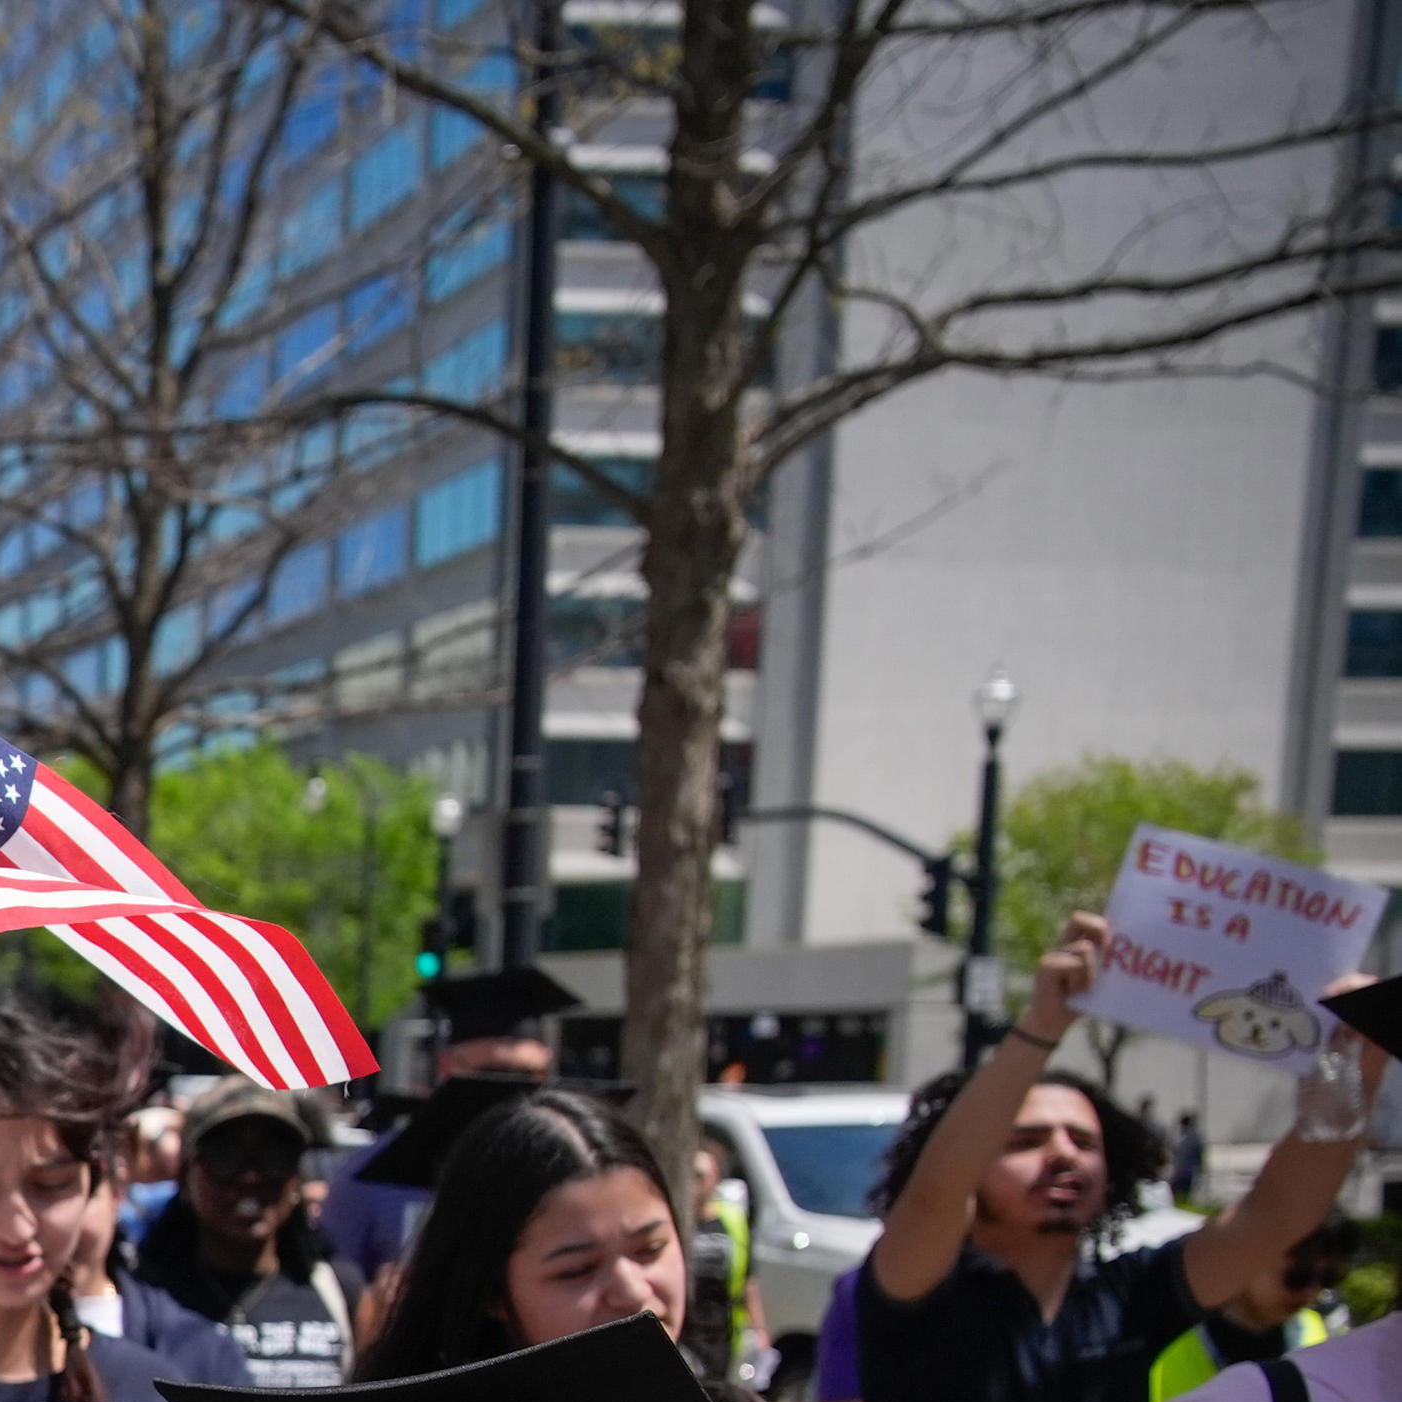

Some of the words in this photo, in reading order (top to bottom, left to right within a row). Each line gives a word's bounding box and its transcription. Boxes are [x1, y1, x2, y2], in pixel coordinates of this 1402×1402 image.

[1137, 838, 1363, 931] EDUCATION
[1168, 896, 1214, 930] IS
[1223, 911, 1252, 943] A
[1100, 932, 1213, 996] RIGHT
